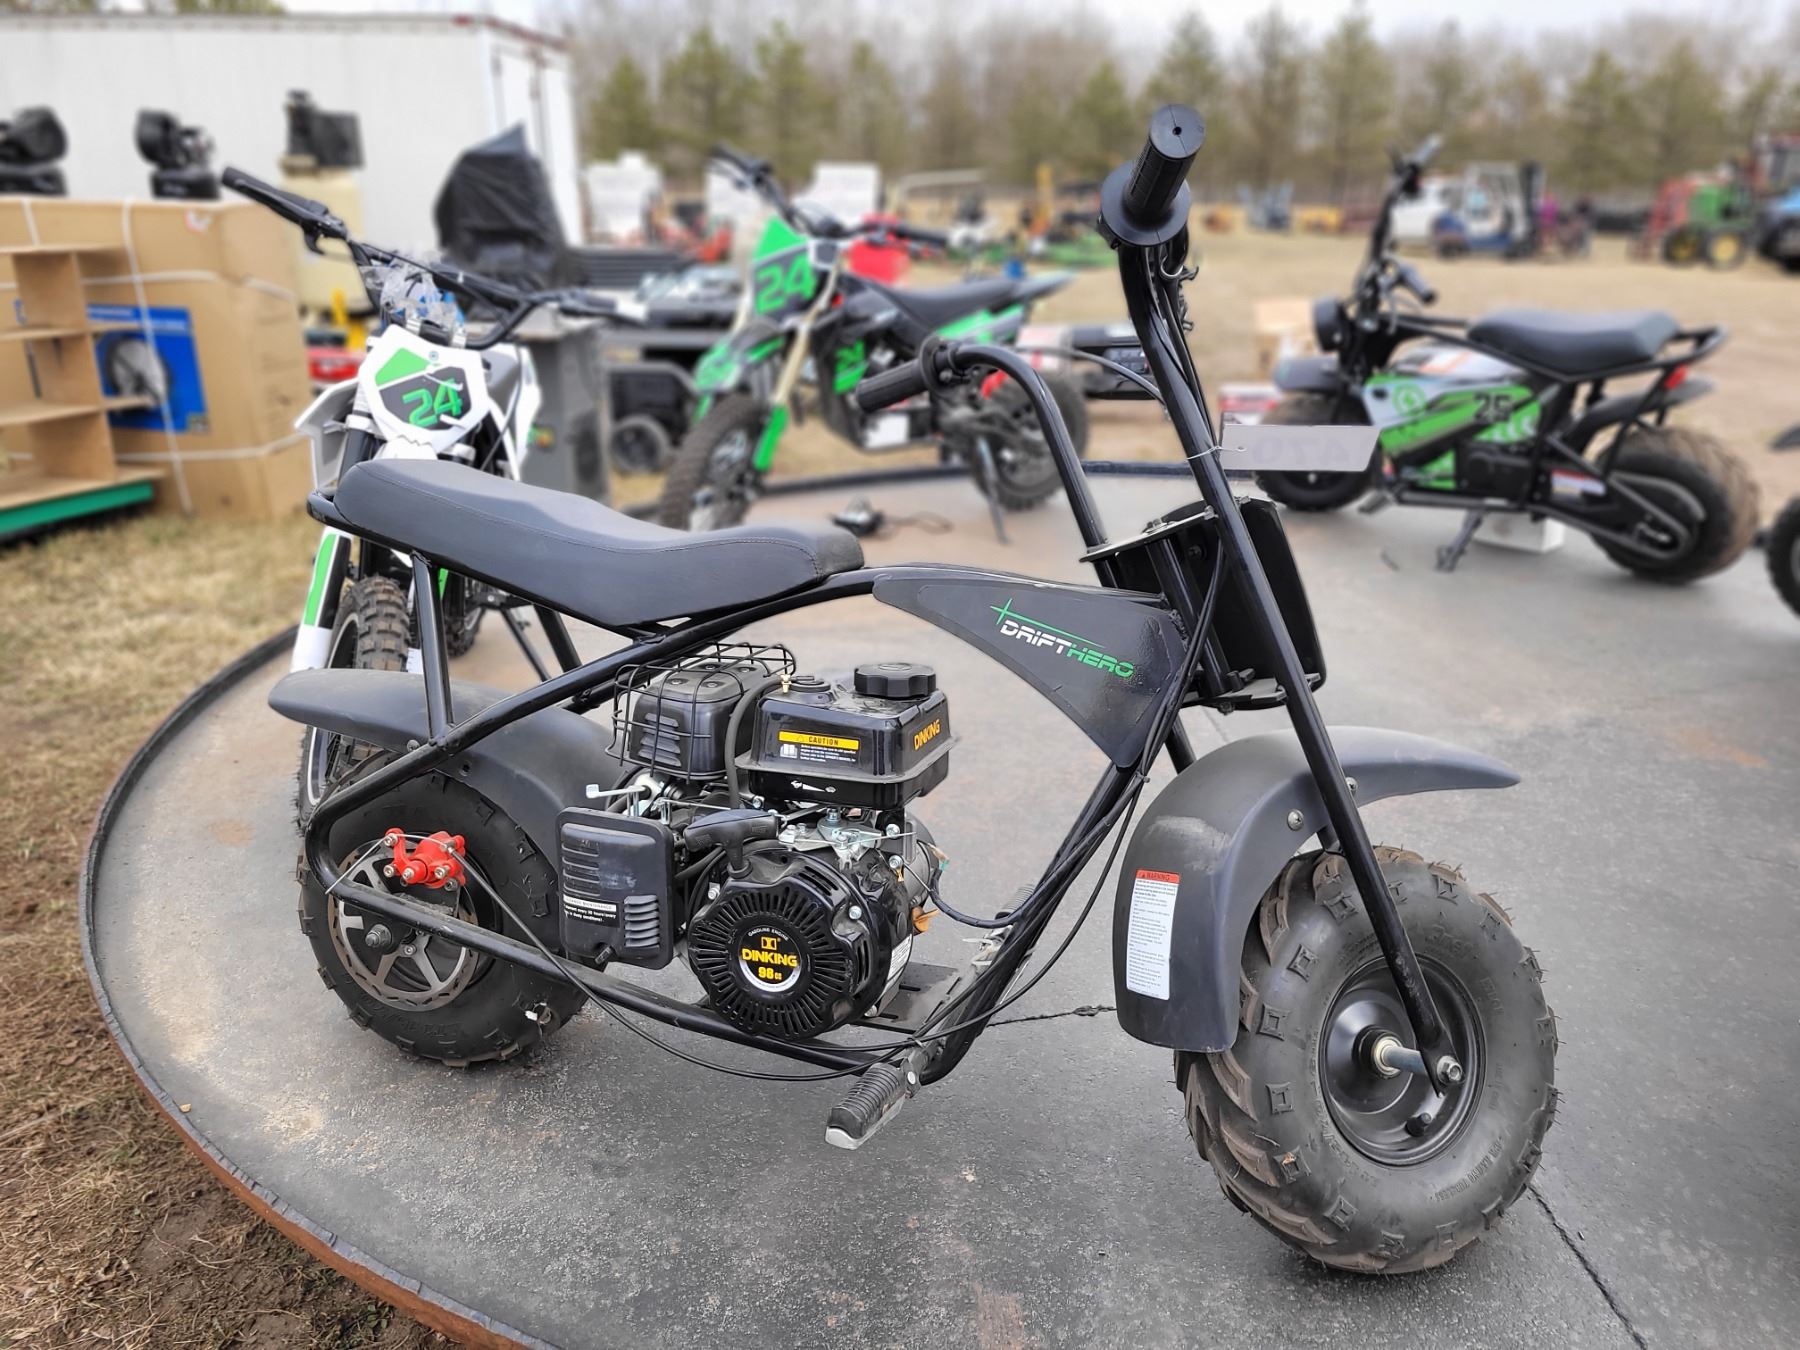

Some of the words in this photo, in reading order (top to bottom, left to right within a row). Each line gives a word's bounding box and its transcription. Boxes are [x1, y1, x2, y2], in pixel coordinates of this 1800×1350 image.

[756, 255, 816, 314] 24
[402, 378, 463, 426] 24
[808, 736, 839, 746] CAUTION
[914, 719, 940, 750] DINKING
[741, 948, 798, 967] DINKING
